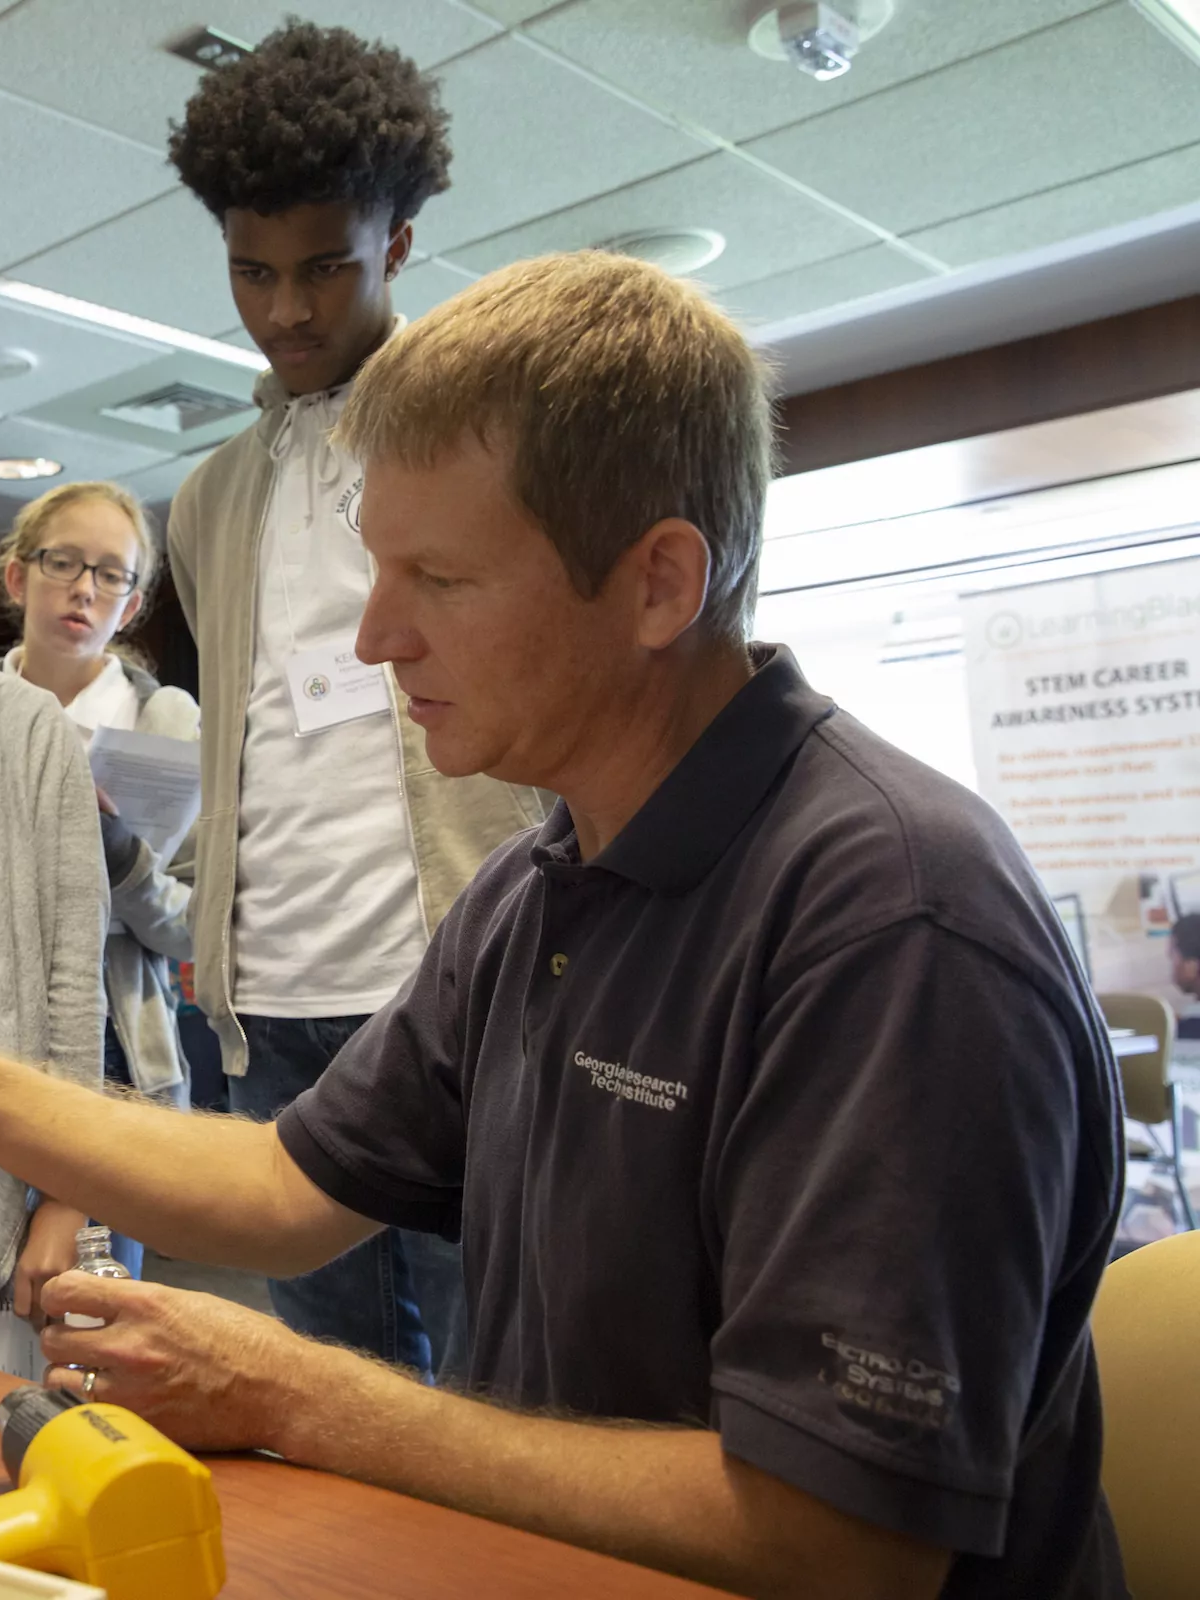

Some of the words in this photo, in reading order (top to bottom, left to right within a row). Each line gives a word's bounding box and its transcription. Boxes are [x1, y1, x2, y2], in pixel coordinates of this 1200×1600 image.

[1025, 671, 1086, 696] STEM
[1093, 659, 1189, 688] CAREER
[991, 697, 1129, 729] AWARENESS
[574, 1051, 626, 1080] Georgia
[624, 1070, 688, 1099] esearch
[590, 1071, 621, 1094] Tech
[621, 1084, 676, 1111] stitute
